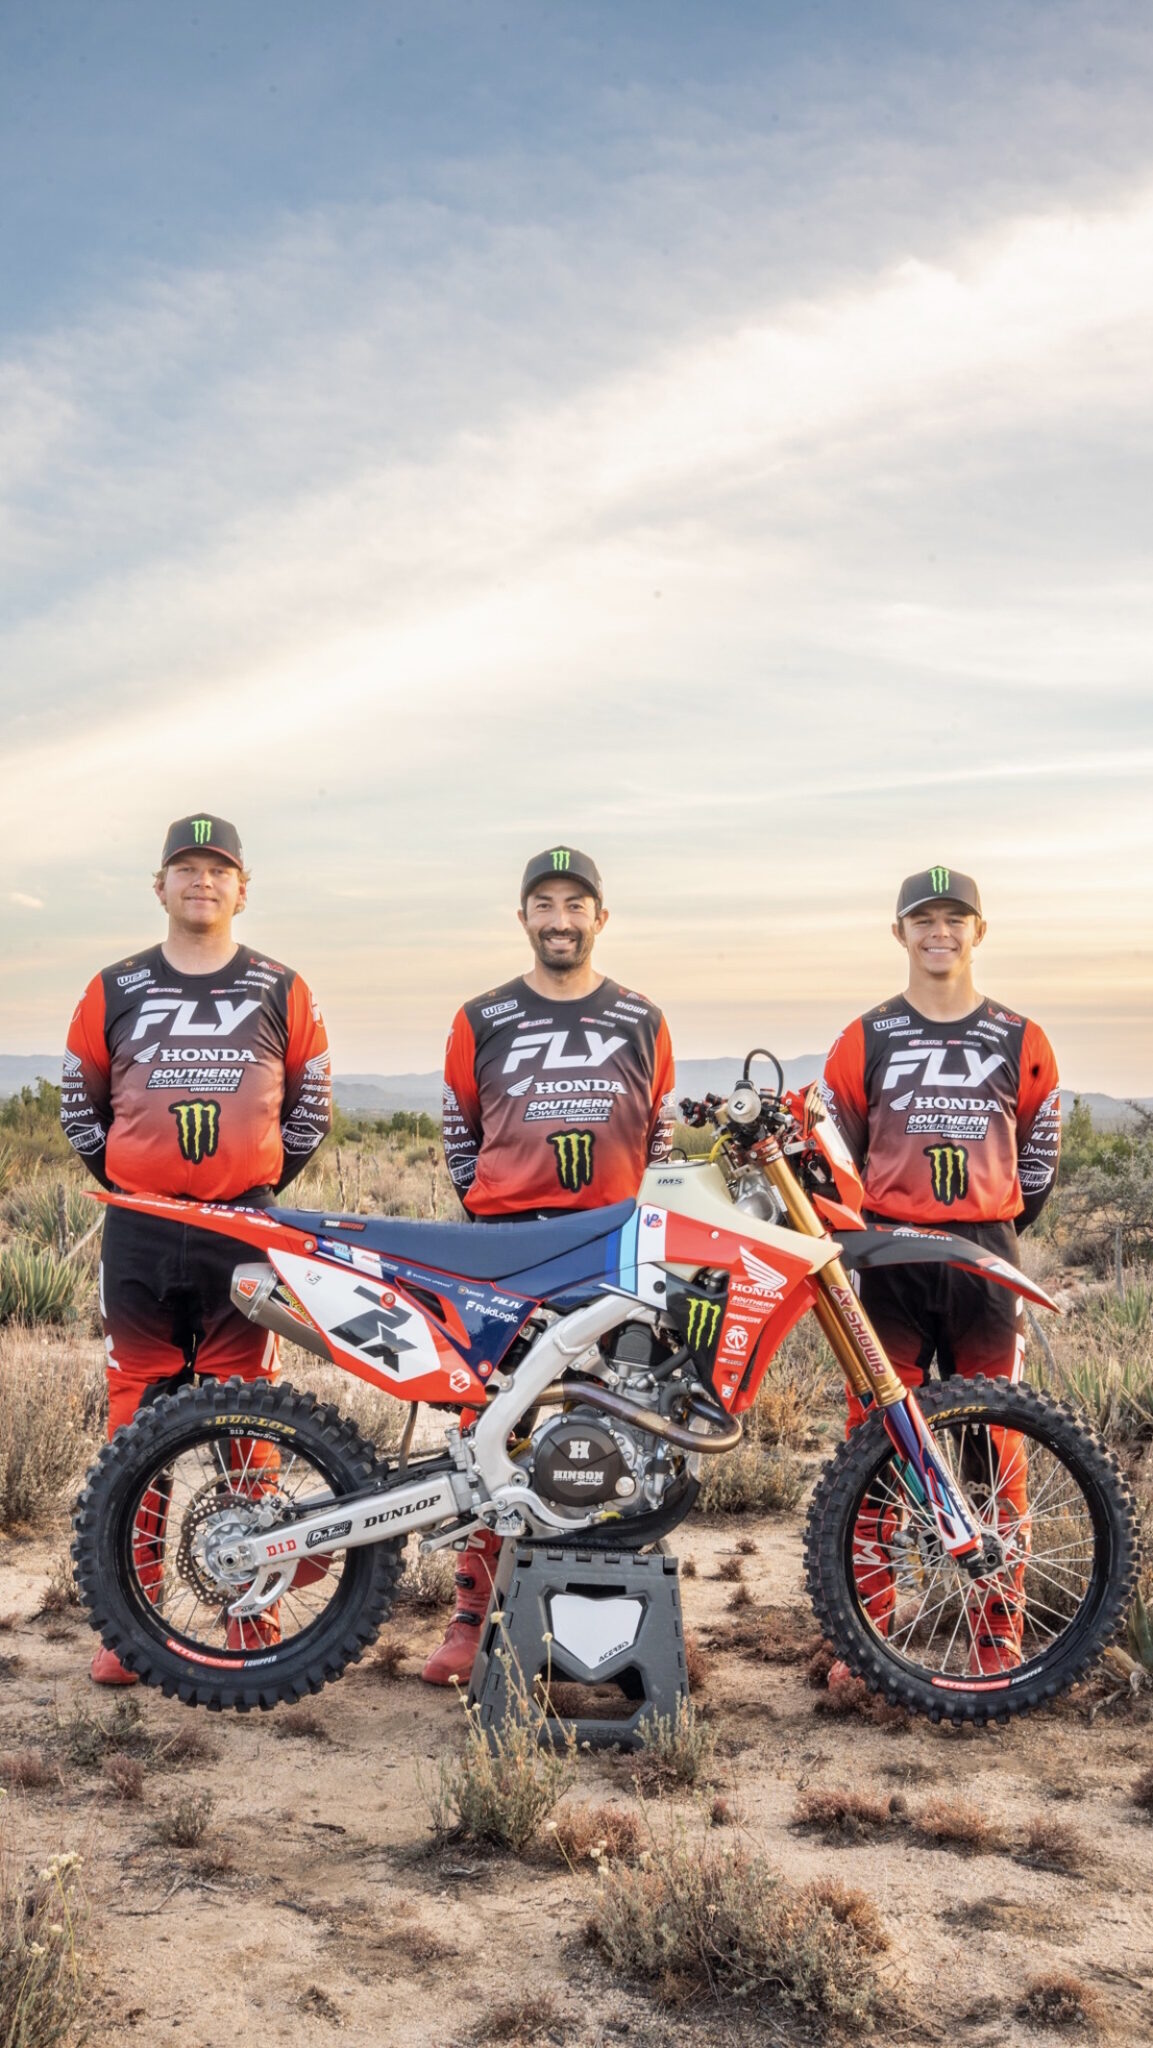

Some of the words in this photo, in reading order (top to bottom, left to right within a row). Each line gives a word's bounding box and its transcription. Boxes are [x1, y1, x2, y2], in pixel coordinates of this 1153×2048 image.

[481, 999, 518, 1018] WPS
[615, 1000, 648, 1016] SHOWA
[131, 999, 262, 1041] FLY
[873, 1015, 910, 1031] WPS
[160, 1048, 258, 1062] HONDA
[502, 1030, 628, 1075] FLY
[151, 1068, 243, 1079] SOUTHERN
[882, 1048, 1006, 1091] FLY
[148, 1078, 240, 1086] POWERSPORTS
[534, 1079, 628, 1095] HONDA
[528, 1098, 613, 1111] SOUTHERN
[914, 1096, 1004, 1112] HONDA
[908, 1114, 989, 1126] SOUTHERN
[892, 1231, 953, 1241] PROPANE
[731, 1281, 784, 1300] HONDA
[731, 1295, 776, 1308] SOUTHERN
[475, 1303, 519, 1322] FluidLogic
[844, 1311, 887, 1377] SHOWA
[215, 1414, 297, 1436] DUNLOP
[569, 1440, 590, 1459] H
[553, 1470, 605, 1480] HINSON
[364, 1494, 441, 1528] DUNLOP
